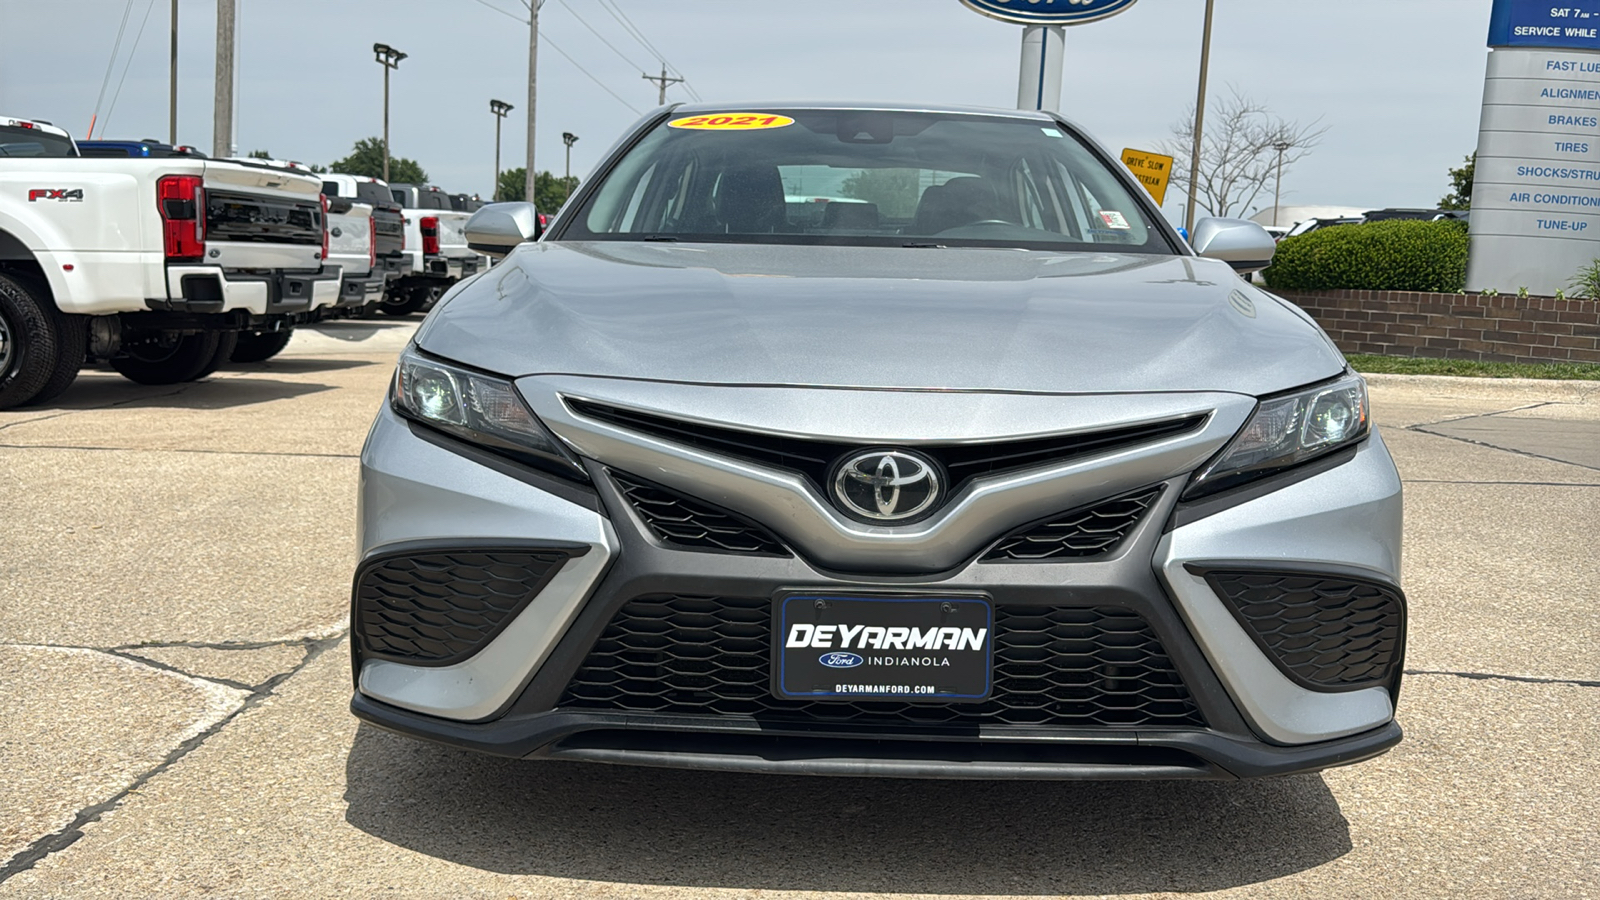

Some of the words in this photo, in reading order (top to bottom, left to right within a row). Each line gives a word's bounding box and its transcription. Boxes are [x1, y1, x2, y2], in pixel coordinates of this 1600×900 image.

[1550, 8, 1571, 18] SAT
[1514, 26, 1561, 37] SERVICE
[1565, 27, 1598, 38] WHILE
[1546, 60, 1577, 72] FAST
[680, 116, 778, 126] 2021
[1548, 114, 1598, 127] BRAKES
[1554, 142, 1589, 153] TIRES
[1126, 157, 1145, 168] DRIVE
[1147, 160, 1164, 171] SLOW
[28, 189, 84, 202] FX4
[1509, 192, 1531, 203] AIR
[1537, 219, 1588, 231] TUNE-UP
[785, 623, 988, 651] DEYARMAN
[868, 656, 951, 667] INDIANOLA
[835, 684, 936, 694] DEYARMANFORD.COM
